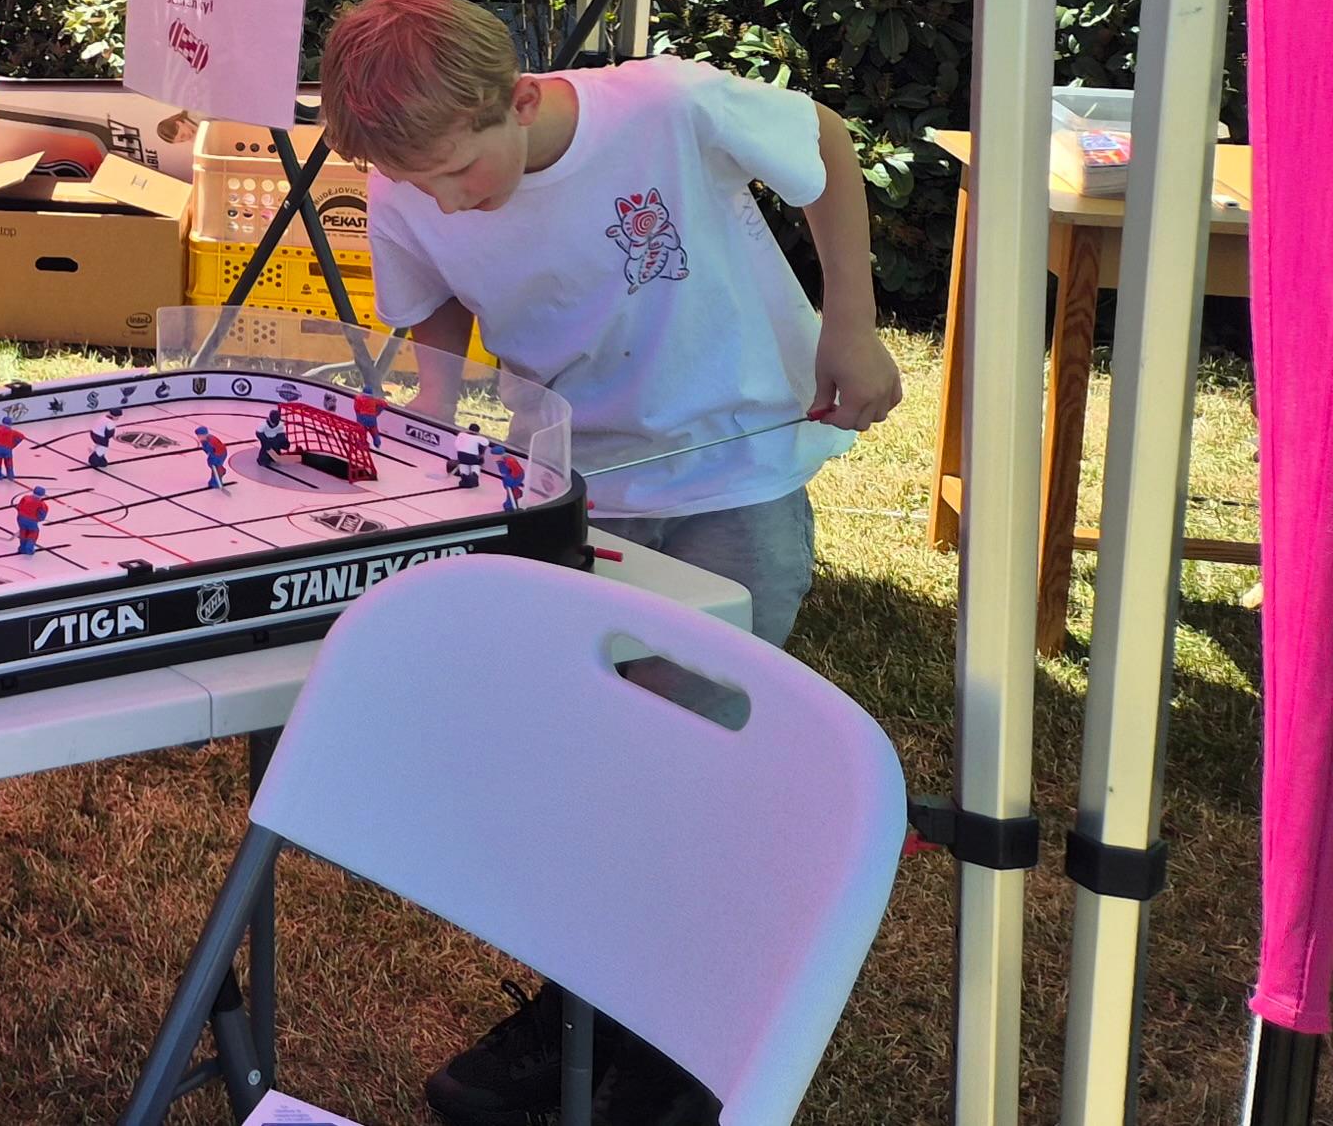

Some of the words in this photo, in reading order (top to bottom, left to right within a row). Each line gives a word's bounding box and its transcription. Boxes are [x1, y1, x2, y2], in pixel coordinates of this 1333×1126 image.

[406, 427, 439, 445] STIGA
[270, 556, 405, 610] STANLEY
[34, 604, 145, 651] STIGA
